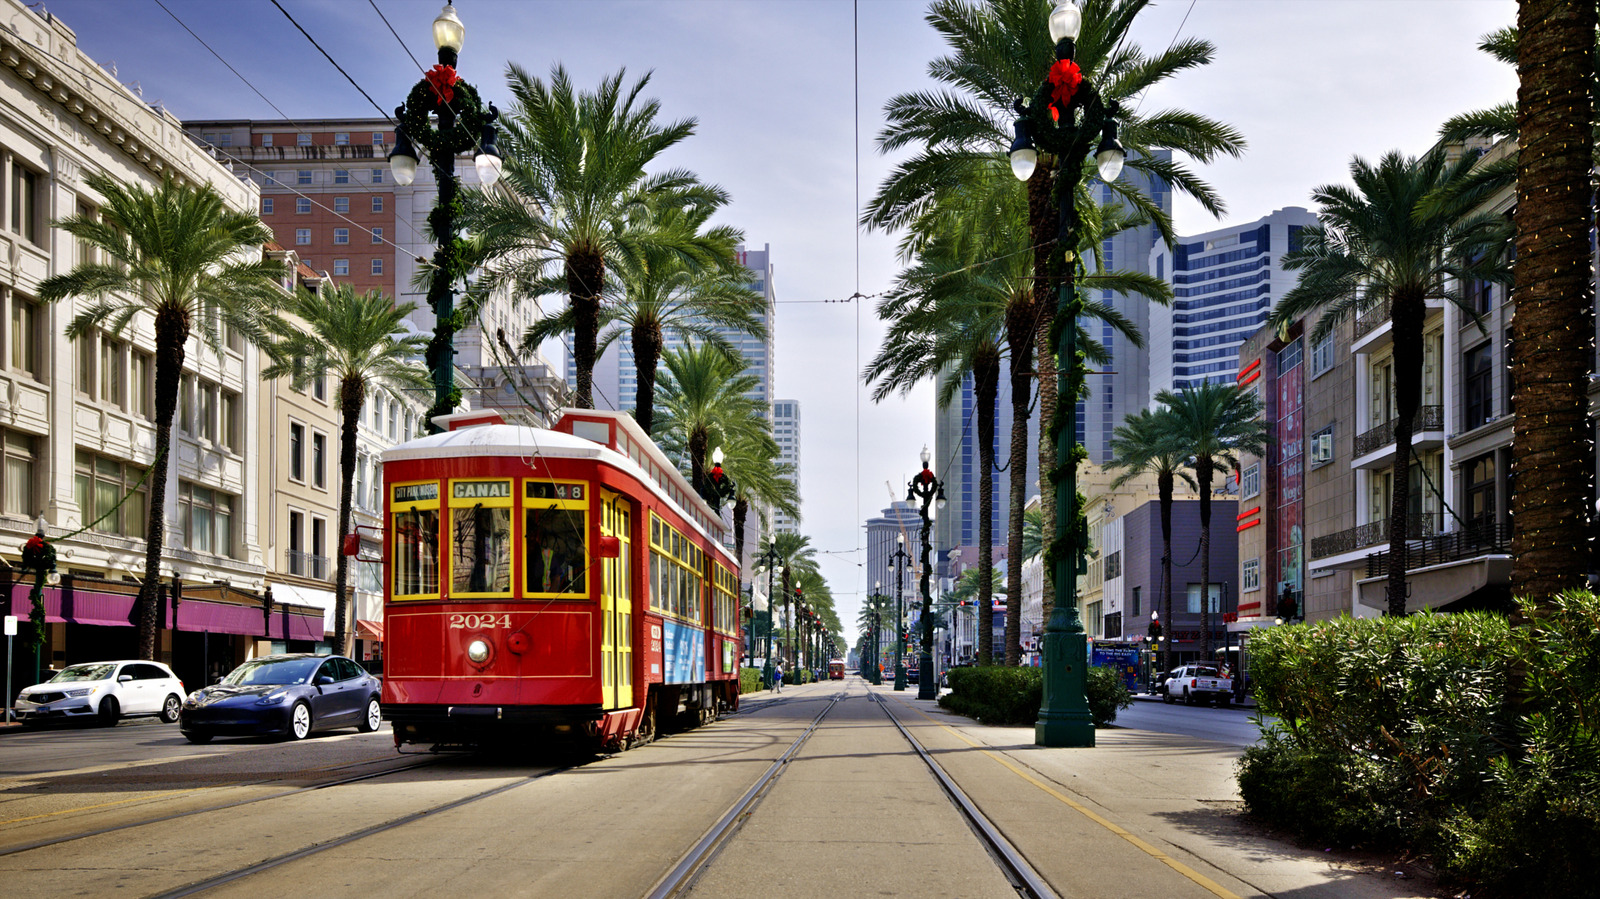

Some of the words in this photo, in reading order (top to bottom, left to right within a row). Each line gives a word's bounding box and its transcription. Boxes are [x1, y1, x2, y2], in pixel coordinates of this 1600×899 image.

[396, 487, 406, 498] CITY
[454, 484, 510, 497] CANAL
[450, 614, 511, 628] 2024
